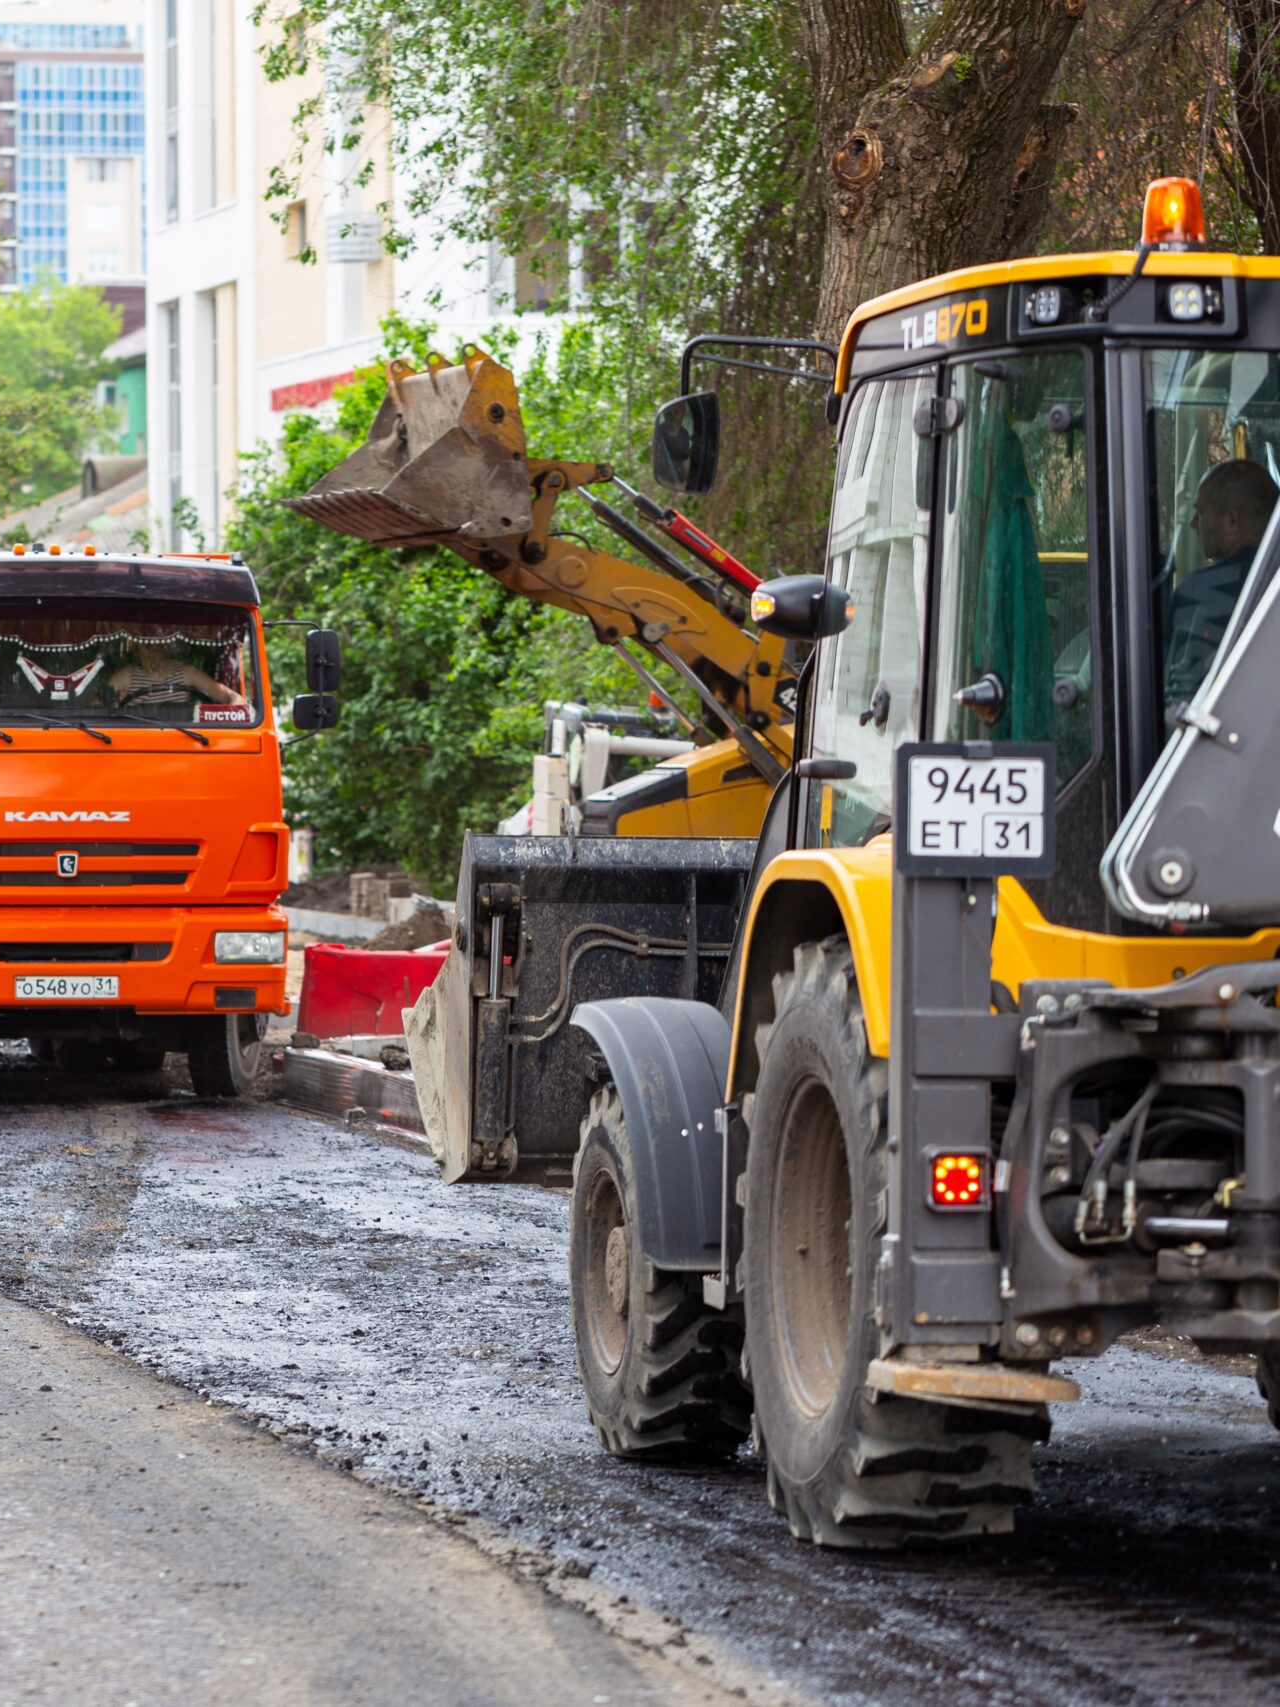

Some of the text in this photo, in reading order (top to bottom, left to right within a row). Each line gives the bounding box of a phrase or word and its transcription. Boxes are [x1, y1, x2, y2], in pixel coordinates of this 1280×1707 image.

[901, 299, 988, 352] TLB870
[204, 710, 246, 721] ПУСТОЙ
[927, 766, 1027, 804] 9445
[4, 811, 131, 822] KAMAZ
[994, 821, 1030, 850] 31
[96, 978, 112, 991] 31
